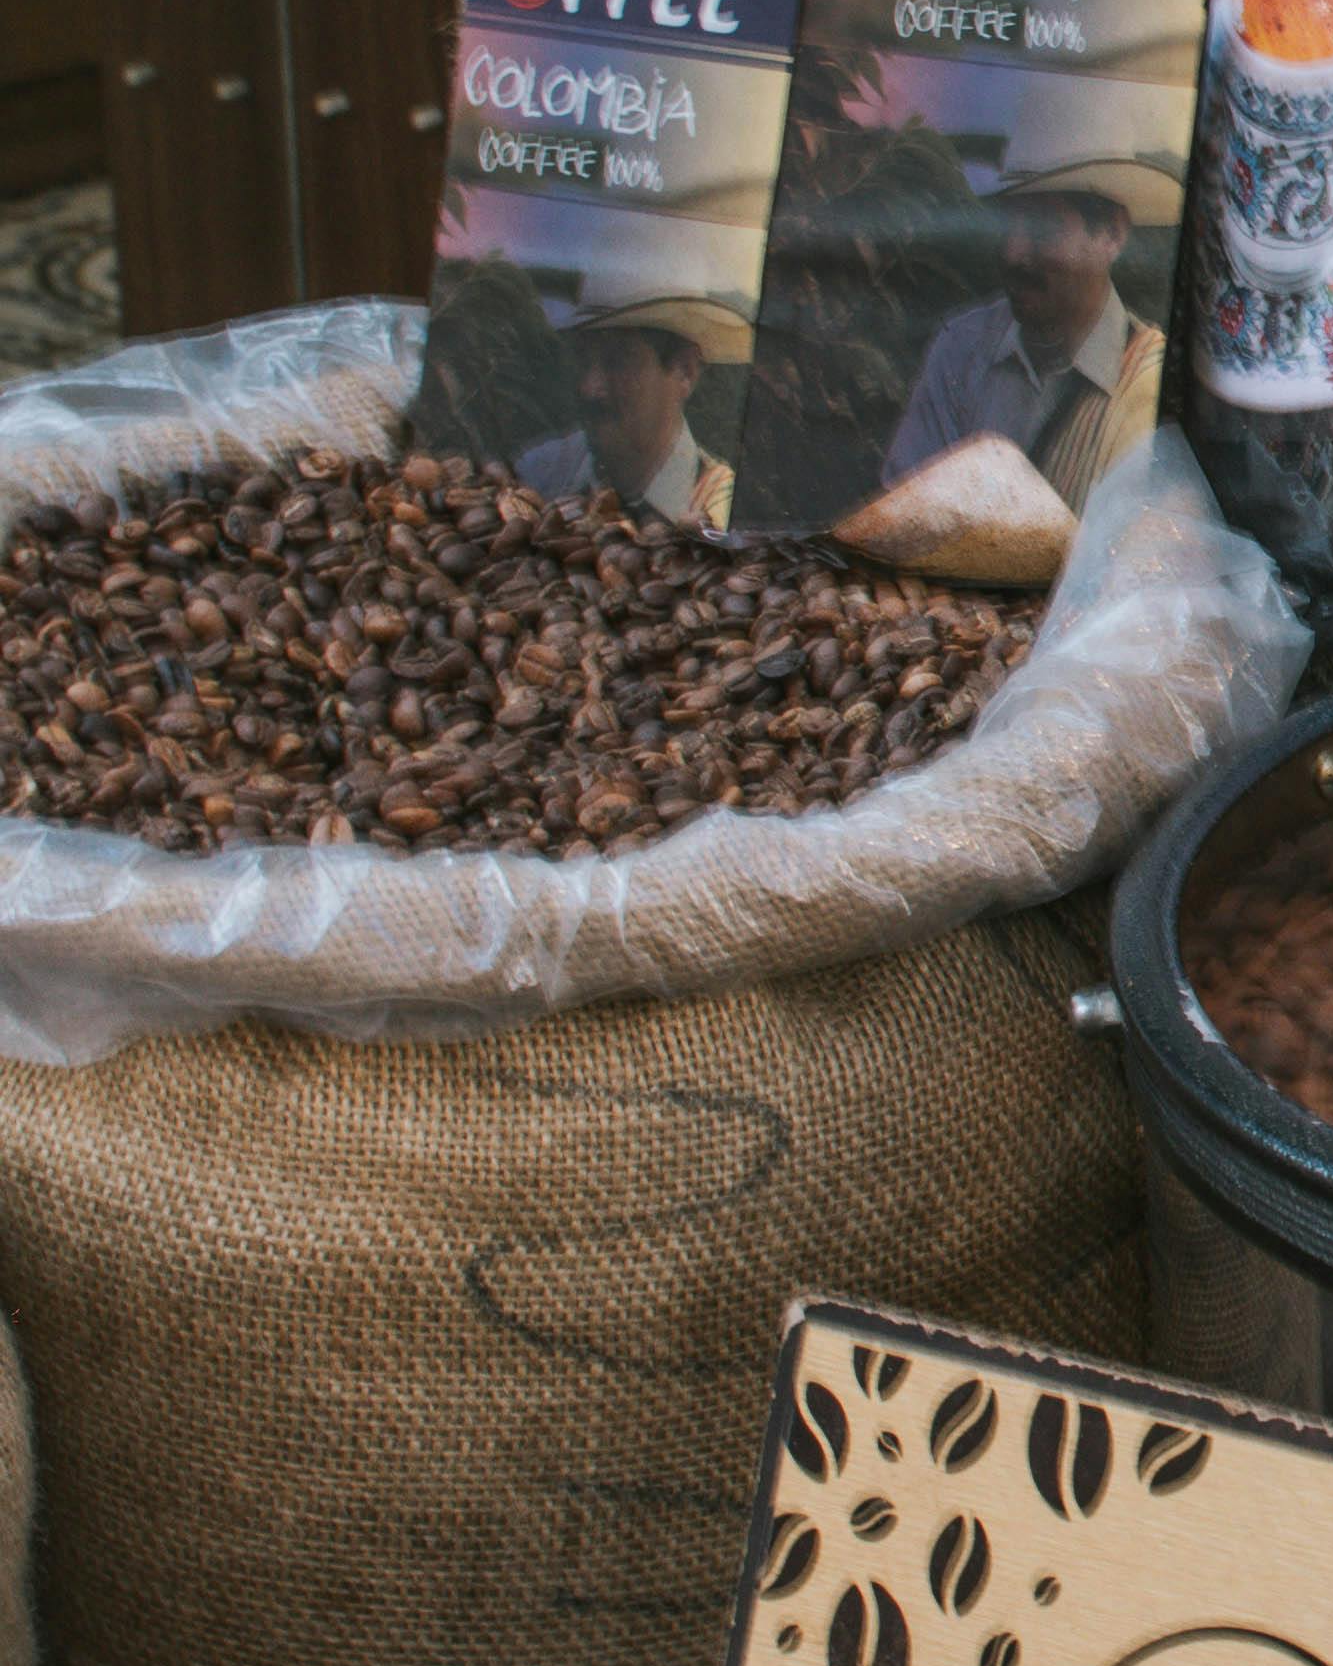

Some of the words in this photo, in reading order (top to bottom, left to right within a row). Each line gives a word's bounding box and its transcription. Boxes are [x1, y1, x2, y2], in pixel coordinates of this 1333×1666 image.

[1023, 5, 1088, 53] 100%
[478, 125, 598, 179] COFFEE
[604, 144, 664, 193] 100%
